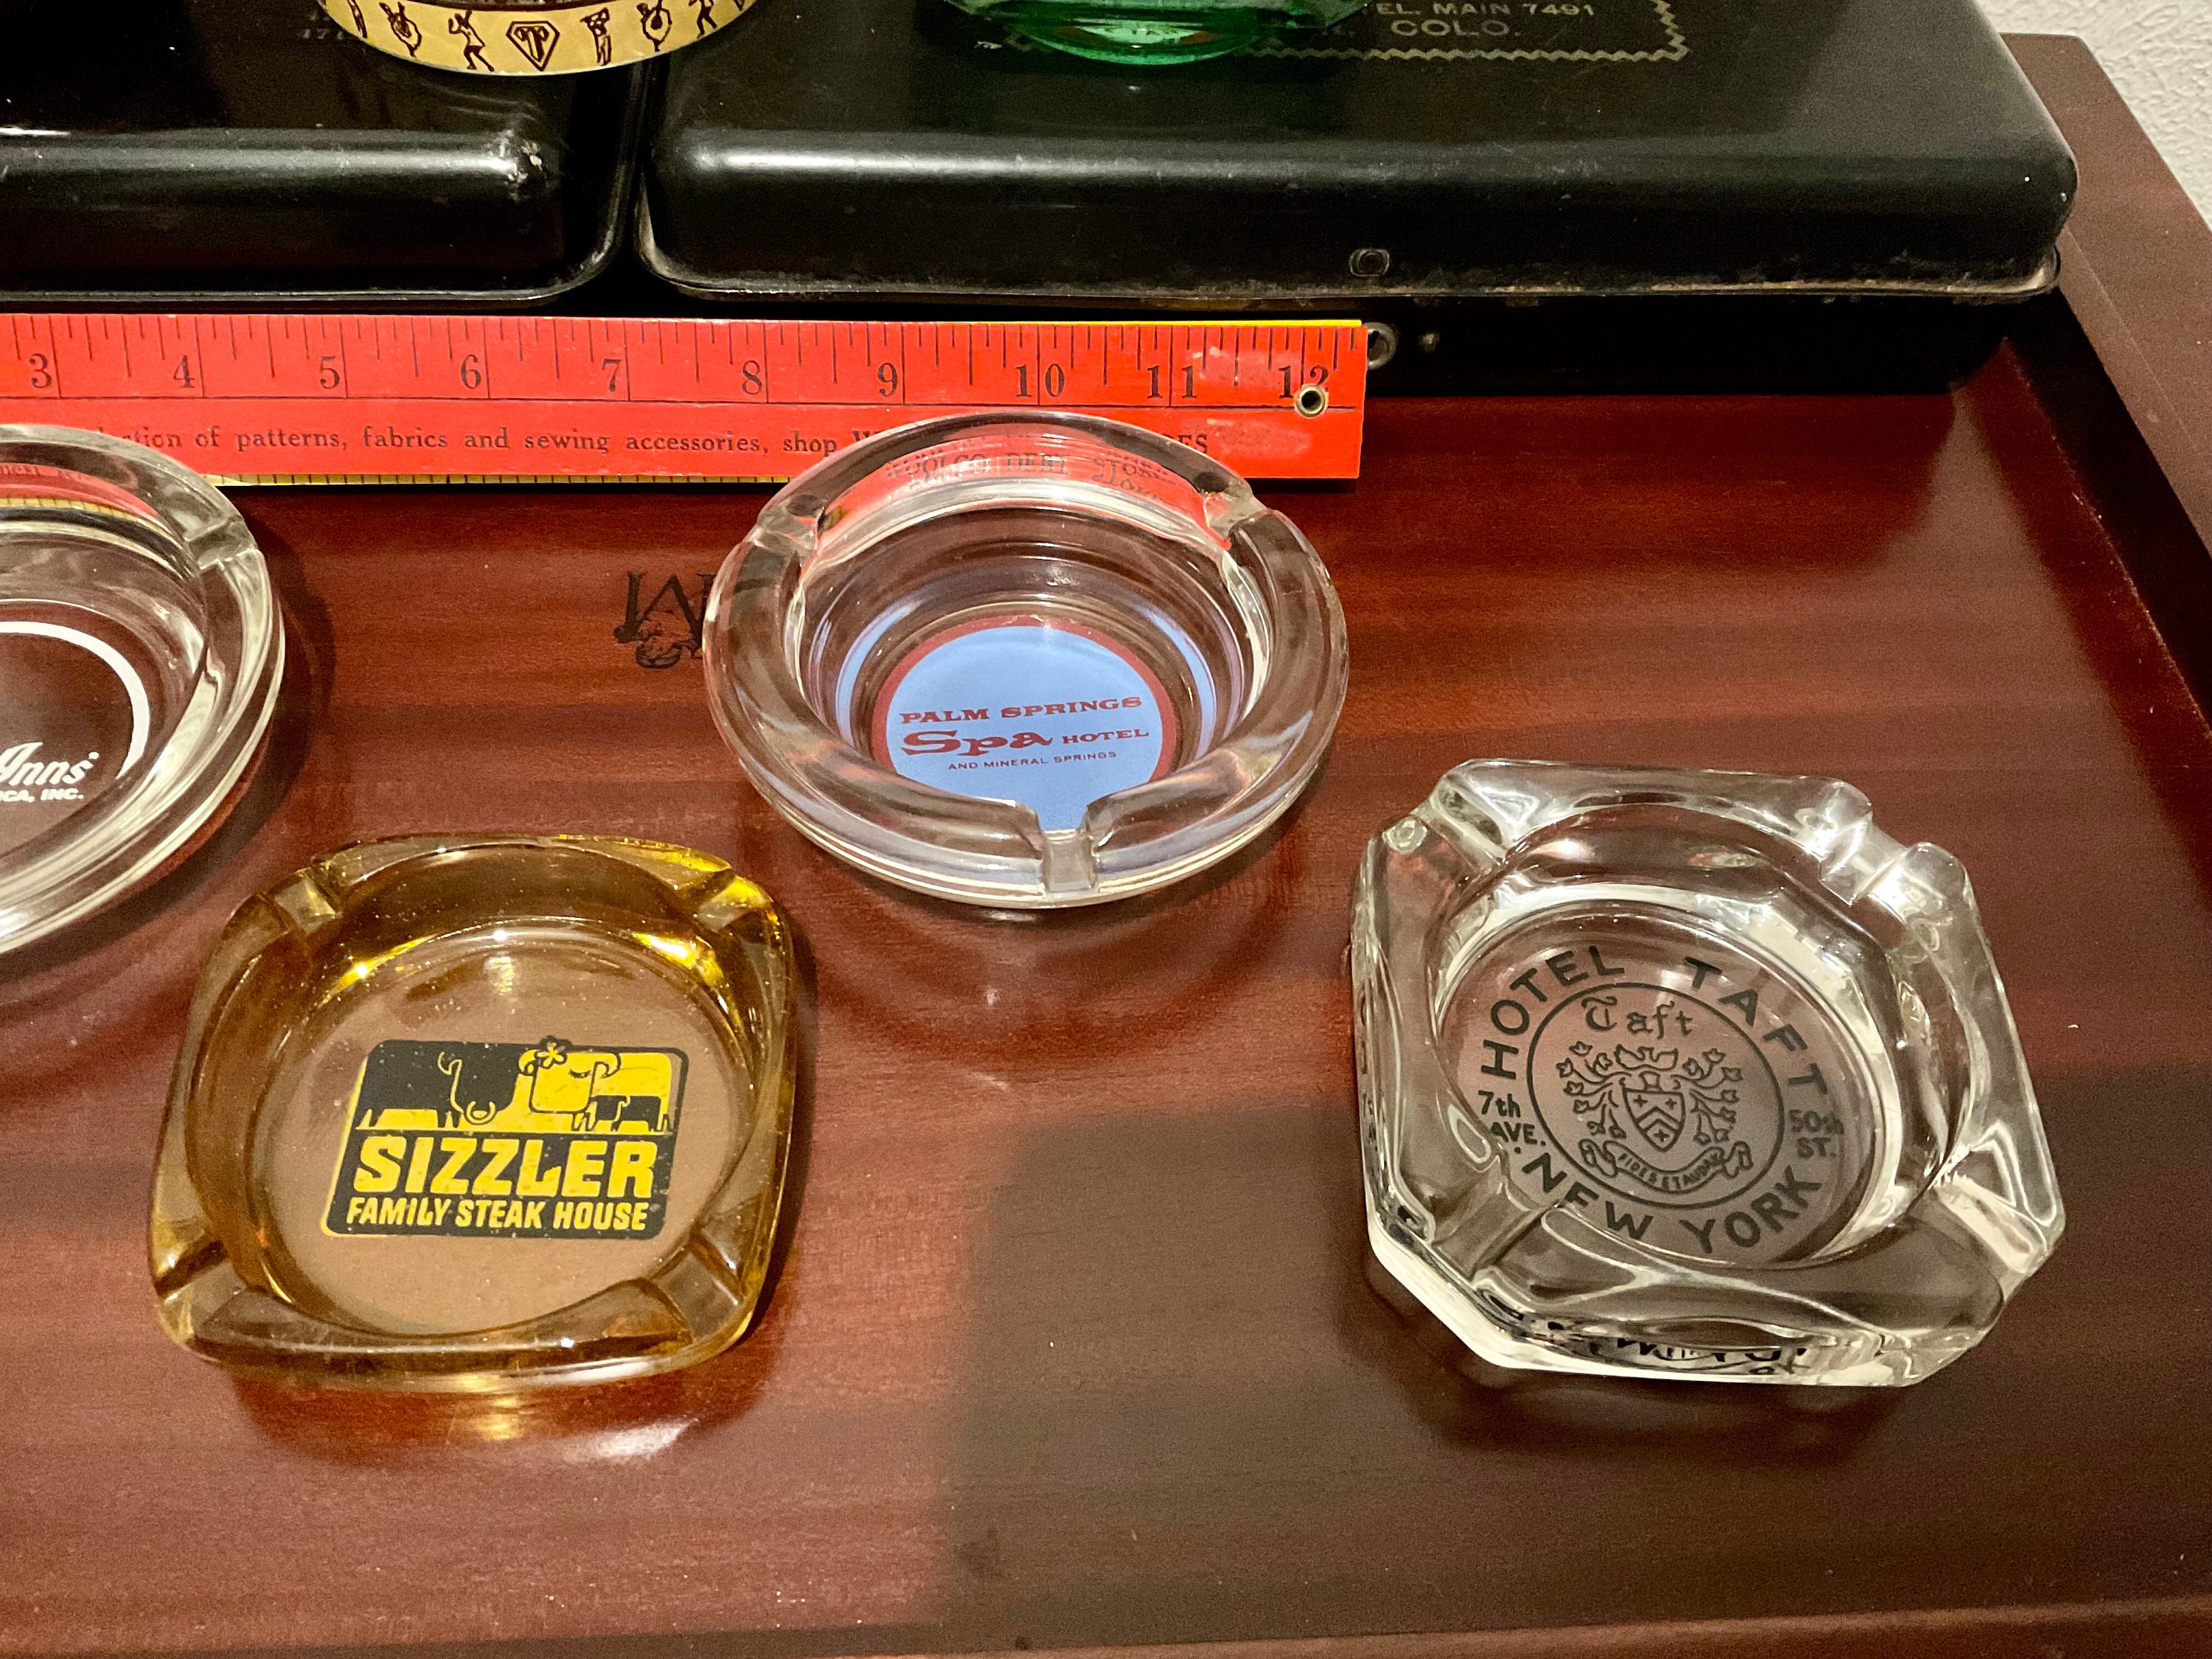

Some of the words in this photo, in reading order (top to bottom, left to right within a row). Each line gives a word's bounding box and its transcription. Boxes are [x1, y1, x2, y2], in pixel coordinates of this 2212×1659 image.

[1376, 2, 1422, 15] EL.
[1433, 2, 1512, 15] MAIN
[1523, 3, 1596, 16] 7491
[1391, 19, 1521, 36] COLO.
[29, 353, 52, 389] 3
[173, 355, 195, 389] 4
[319, 356, 341, 389] 5
[460, 354, 481, 390] 6
[602, 359, 621, 392] 7
[741, 361, 762, 395] 8
[877, 363, 898, 397] 9
[1015, 364, 1065, 397] 10
[1147, 365, 1197, 399] 11
[195, 425, 220, 447] of
[236, 429, 347, 451] patterns,
[363, 425, 448, 448] fabrics
[465, 427, 509, 448] and
[524, 429, 610, 452] sewing
[626, 431, 768, 455] accessories,
[783, 432, 838, 457] shop
[899, 709, 990, 724] PALM
[1001, 696, 1143, 719] SPRINGS
[900, 729, 1053, 757] Spa
[1062, 728, 1150, 744] HOTEL
[947, 762, 978, 770] AND
[984, 758, 1048, 768] MINERAL
[1054, 751, 1117, 763] SPRINGS
[41, 788, 84, 801] INC.
[1480, 945, 1625, 1080] HOTEL
[1684, 956, 1829, 1096] TAFT
[1581, 995, 1694, 1040] Taft
[1478, 1090, 1521, 1117] 7th
[1490, 1121, 1546, 1147] AVE.
[354, 1135, 658, 1198] SIZZLER
[347, 1197, 449, 1227] FAMILY
[455, 1200, 545, 1229] STEAK
[553, 1201, 647, 1231] HOUSE
[1522, 1152, 1654, 1241] NEW
[1679, 1166, 1821, 1253] YORK
